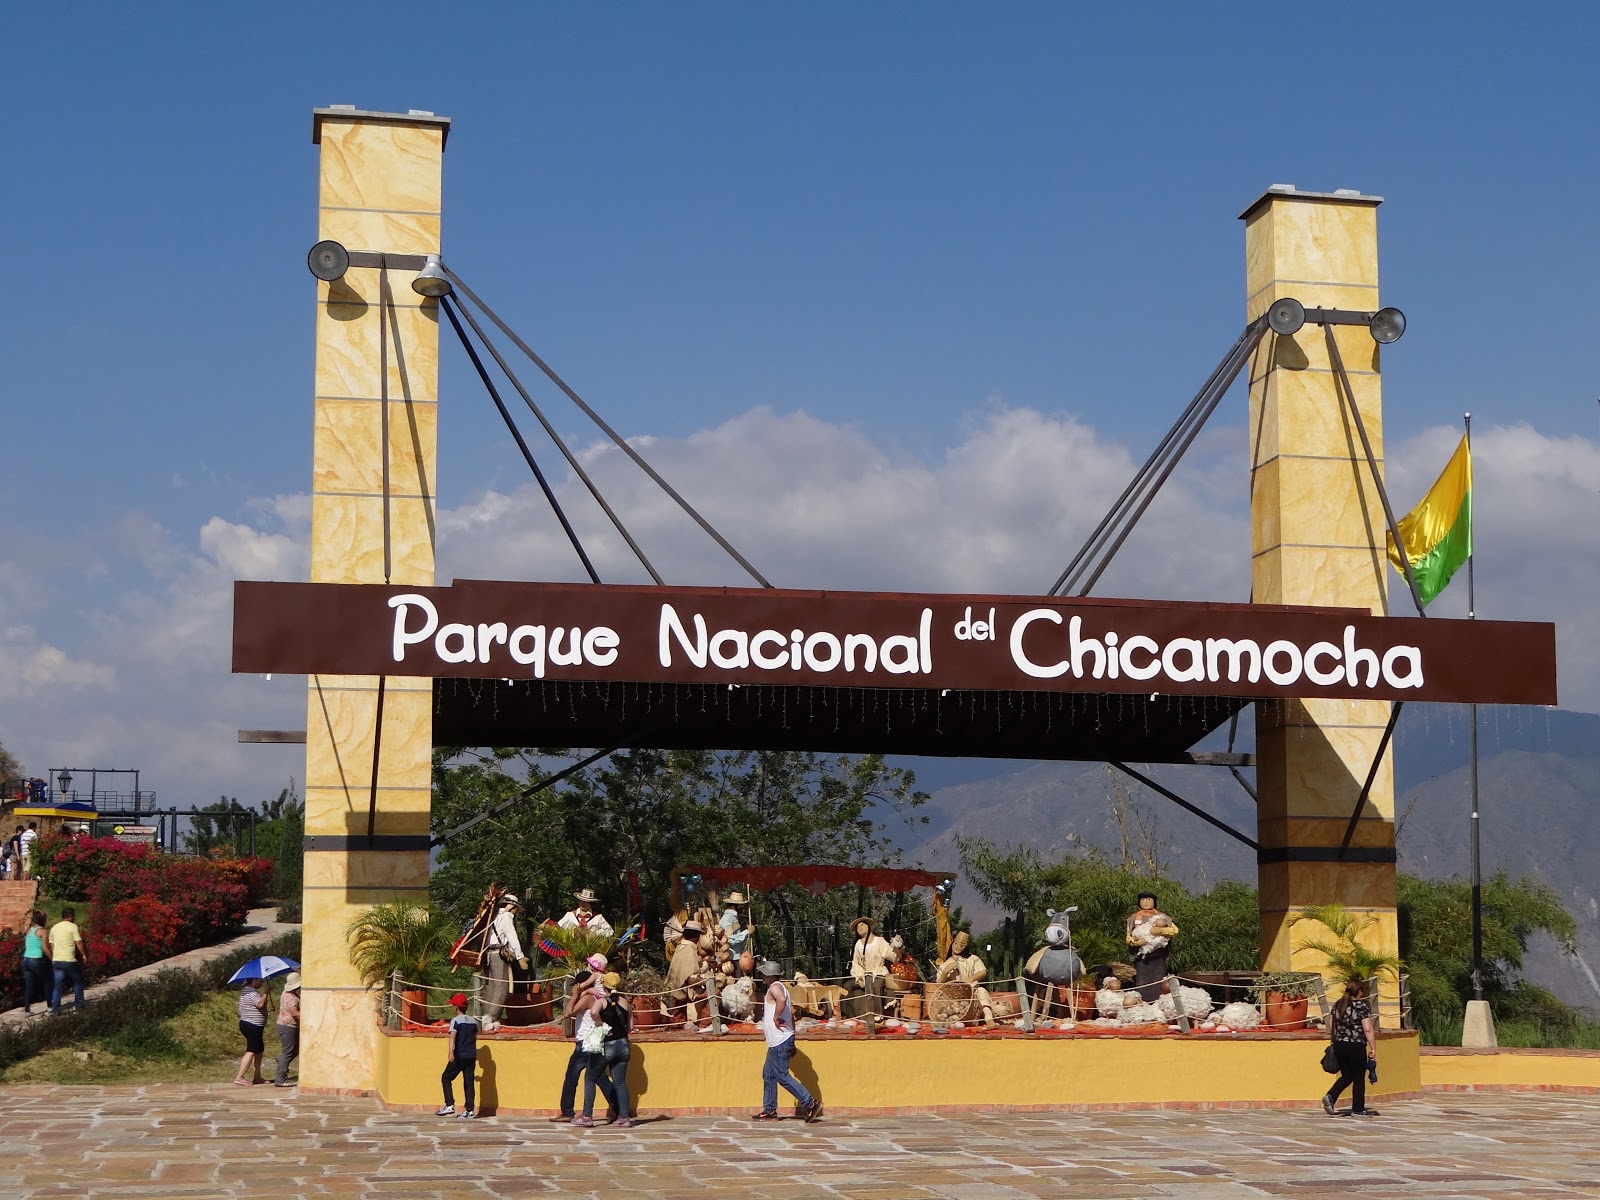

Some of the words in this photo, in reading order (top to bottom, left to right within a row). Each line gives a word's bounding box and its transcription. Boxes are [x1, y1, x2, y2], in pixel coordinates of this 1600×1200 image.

[387, 593, 620, 679] Parque
[658, 603, 933, 674] Nacional
[954, 606, 996, 641] del
[1009, 608, 1424, 689] Chicamocha
